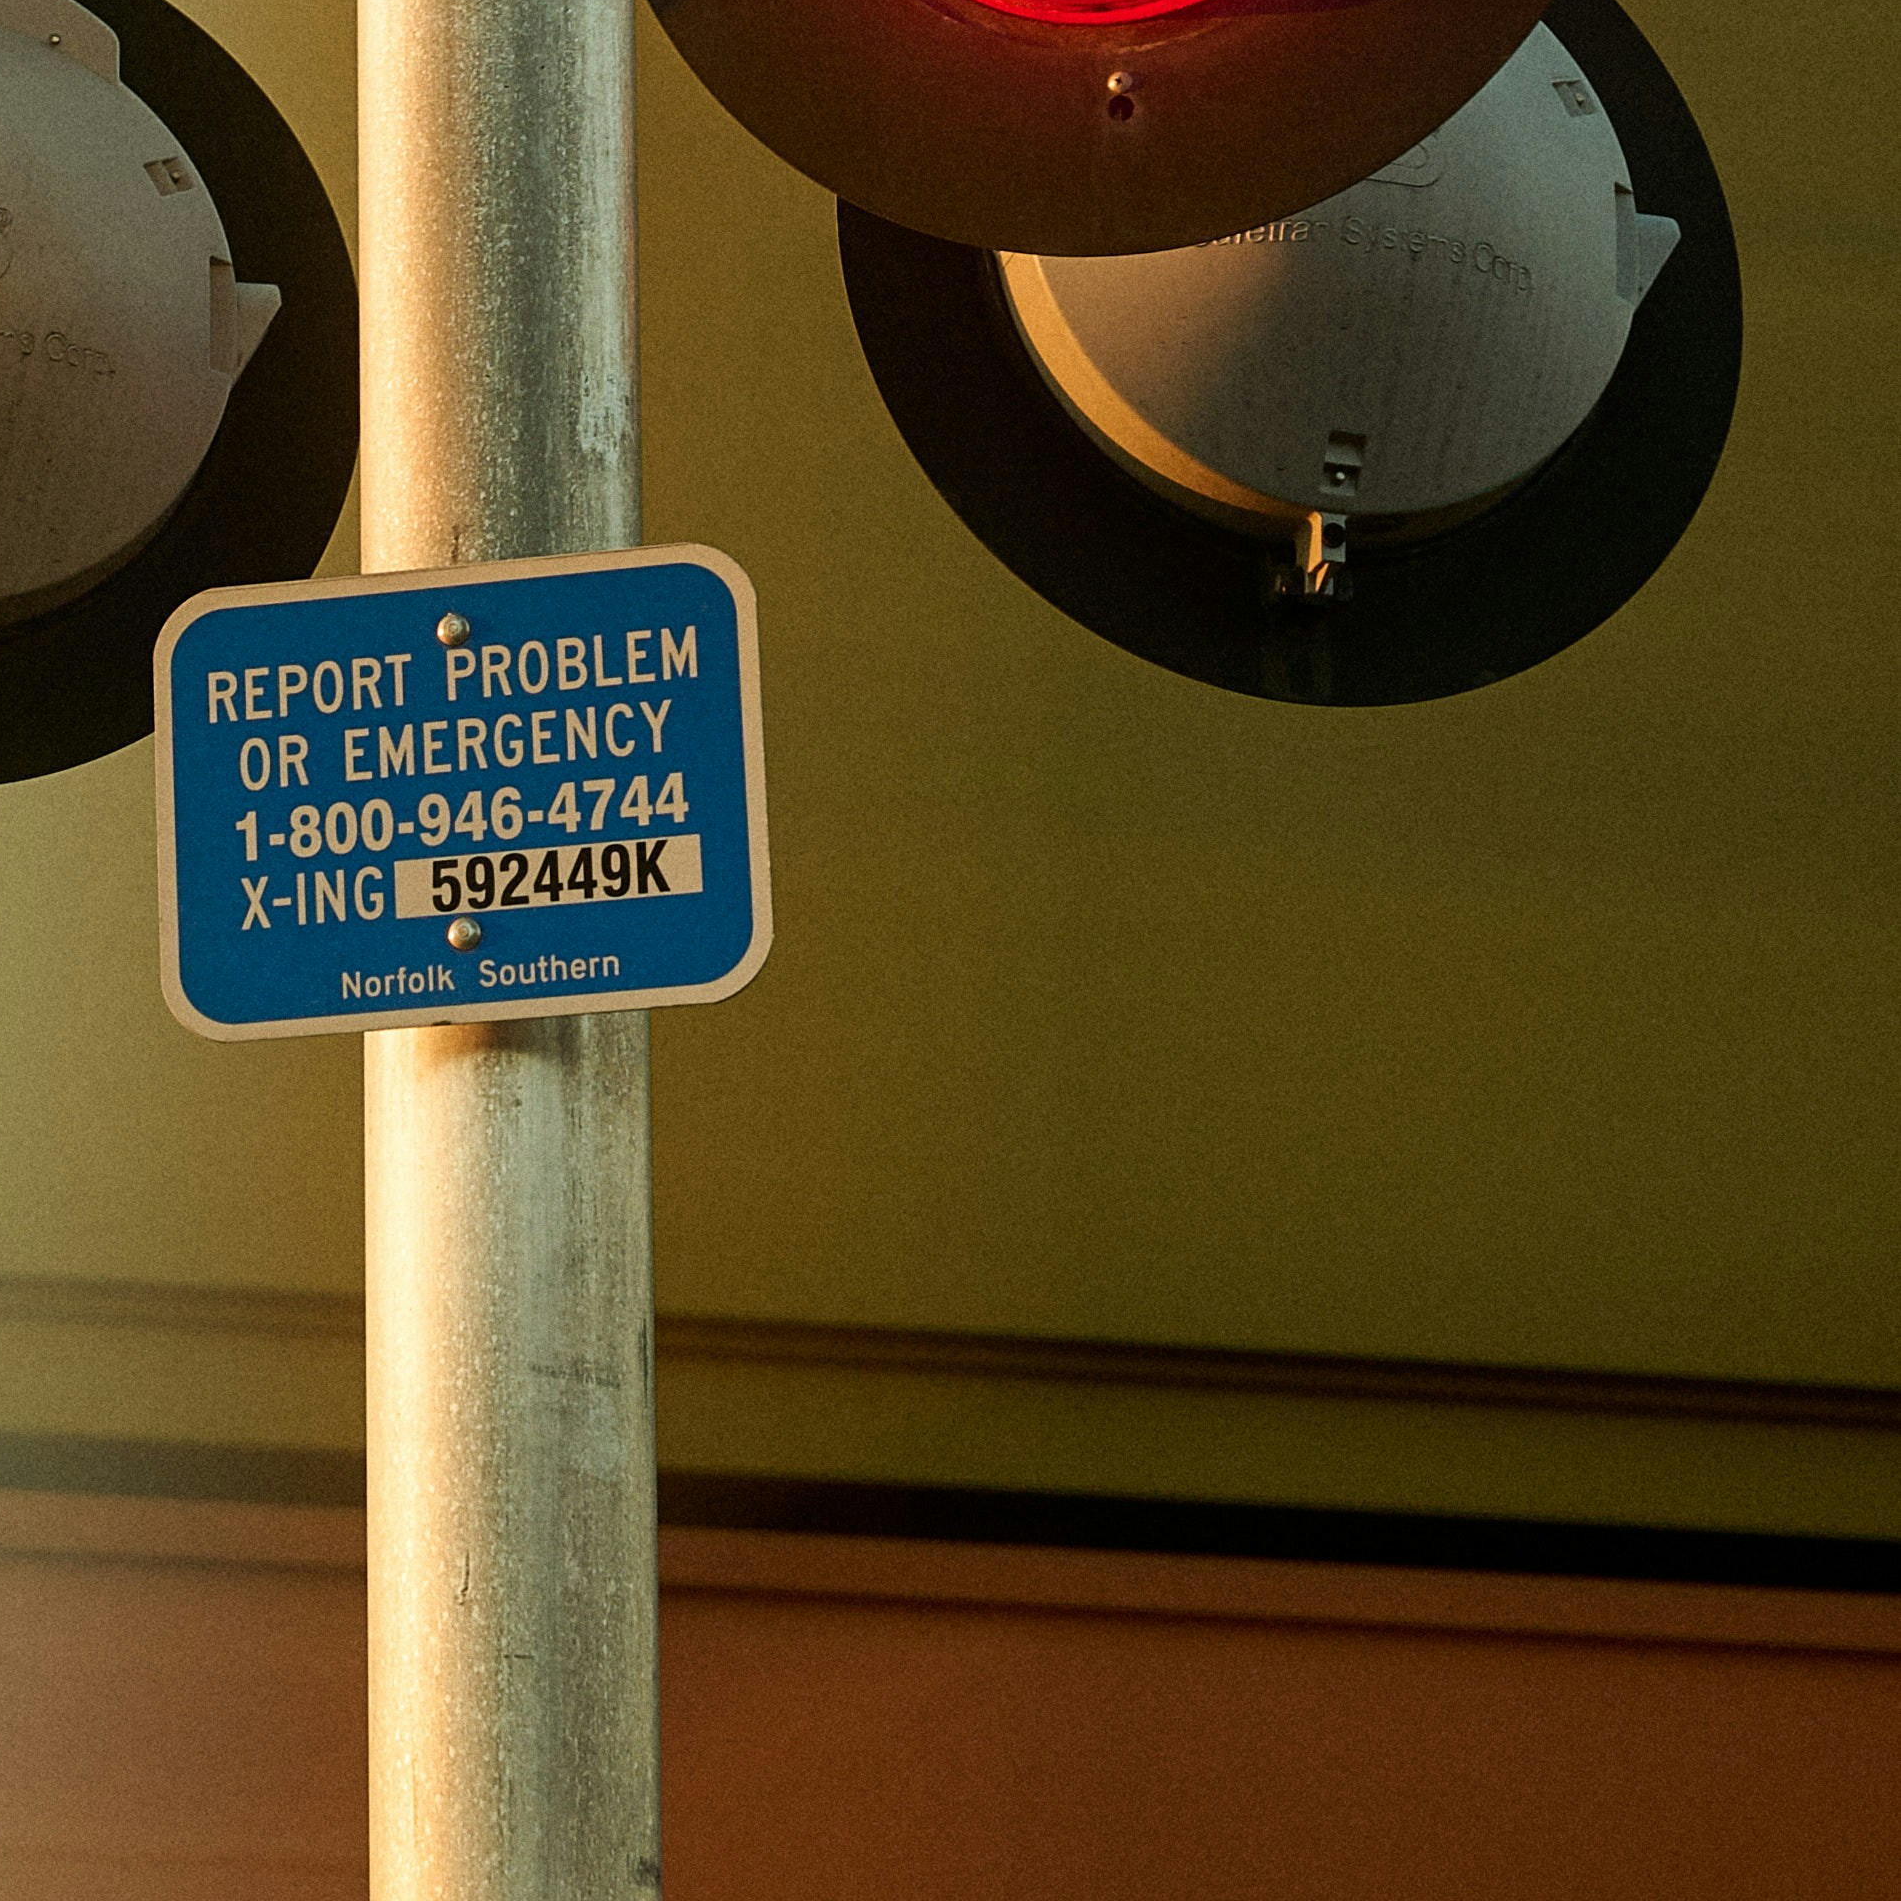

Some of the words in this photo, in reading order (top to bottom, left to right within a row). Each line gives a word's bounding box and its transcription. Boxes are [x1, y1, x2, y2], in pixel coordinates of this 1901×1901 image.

[207, 653, 413, 724] REPORT
[446, 625, 699, 702] PROBLEM
[239, 734, 310, 791] OR
[343, 699, 673, 782] EMERGENCY
[235, 771, 690, 863] 1-800-946-4744
[240, 865, 386, 931] X-ING
[430, 839, 672, 915] 592449K
[340, 964, 456, 1000] Norfolk
[478, 953, 621, 989] Southern
